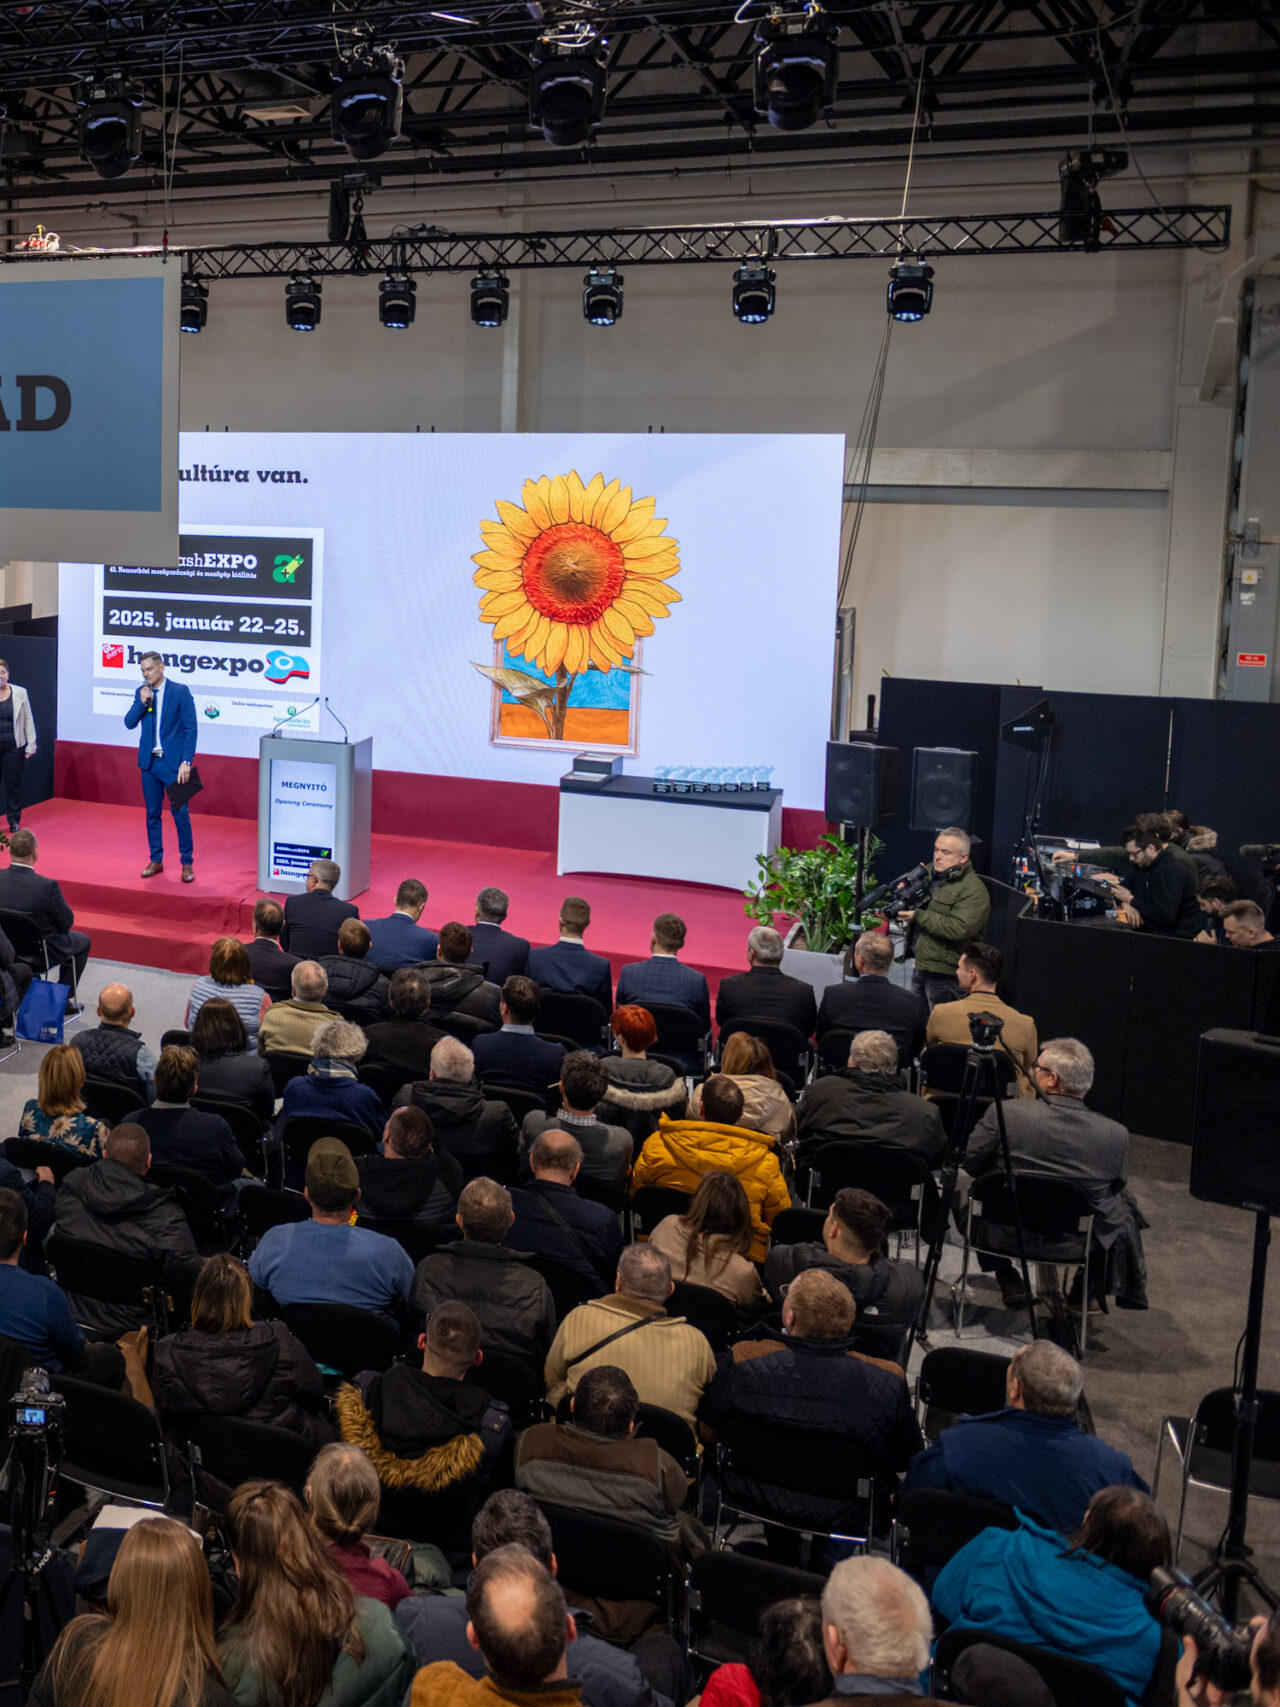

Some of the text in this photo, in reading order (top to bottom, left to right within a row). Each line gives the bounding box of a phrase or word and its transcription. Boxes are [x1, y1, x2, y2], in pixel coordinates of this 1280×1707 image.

[178, 464, 308, 484] ultúra van.
[178, 552, 257, 570] ashEXPO
[109, 609, 160, 628] 2025.
[165, 612, 234, 632] január
[127, 645, 264, 677] hngexpo
[281, 781, 327, 792] MEGNYITÓ
[275, 798, 333, 809] Opening Ceremony
